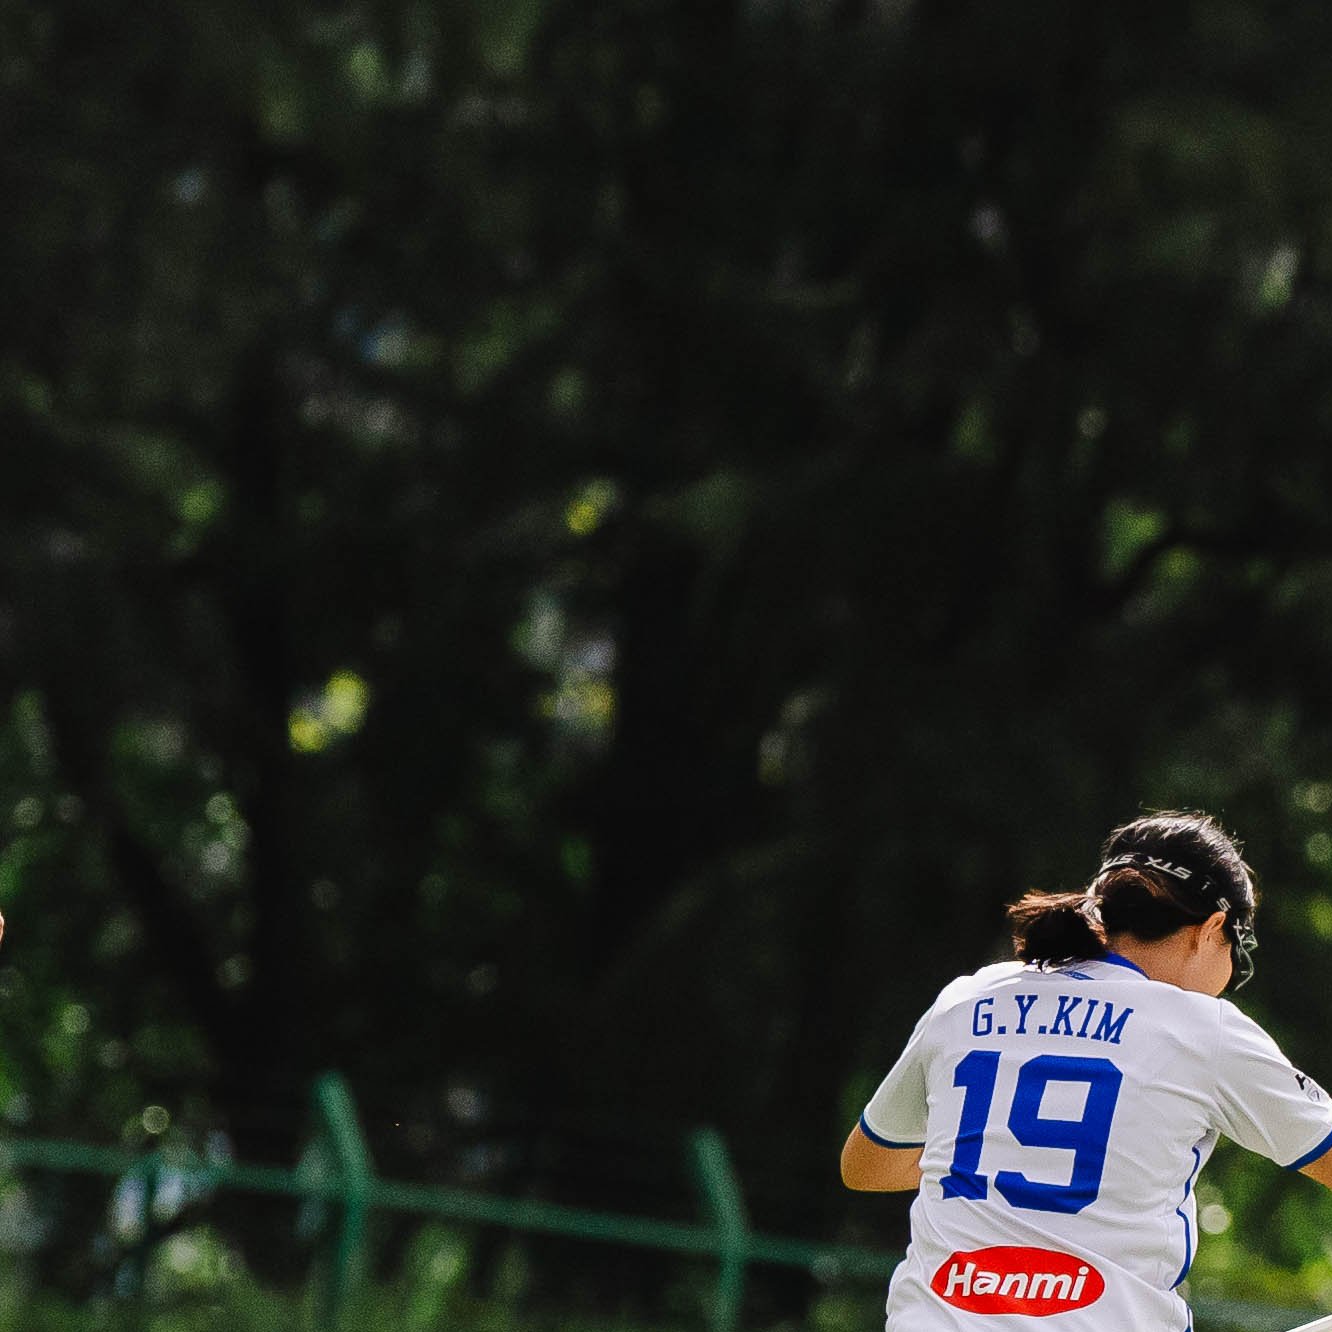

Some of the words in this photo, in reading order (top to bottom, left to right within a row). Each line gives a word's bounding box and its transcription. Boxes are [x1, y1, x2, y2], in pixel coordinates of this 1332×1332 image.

[1144, 856, 1192, 879] STX
[972, 994, 1134, 1045] G.Y.KIM
[939, 1050, 1123, 1215] 19
[942, 1262, 1090, 1301] Hanmi
